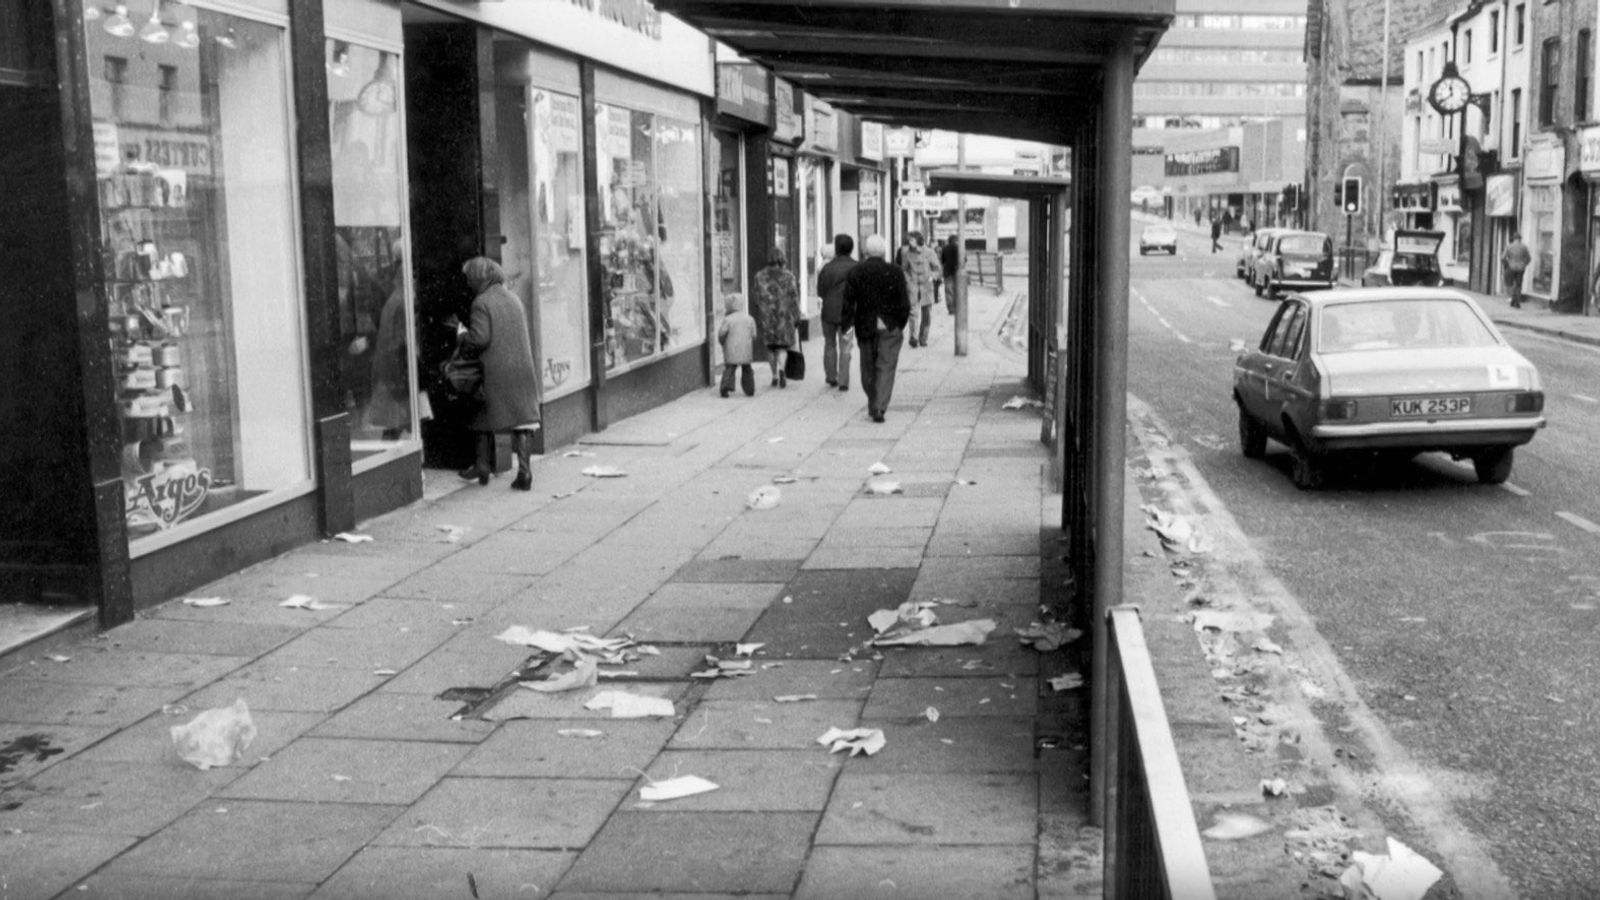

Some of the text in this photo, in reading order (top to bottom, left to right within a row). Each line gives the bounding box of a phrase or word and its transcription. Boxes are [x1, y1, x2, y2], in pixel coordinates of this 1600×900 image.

[1392, 398, 1469, 415] KUK 253P
[125, 467, 210, 523] Argos
